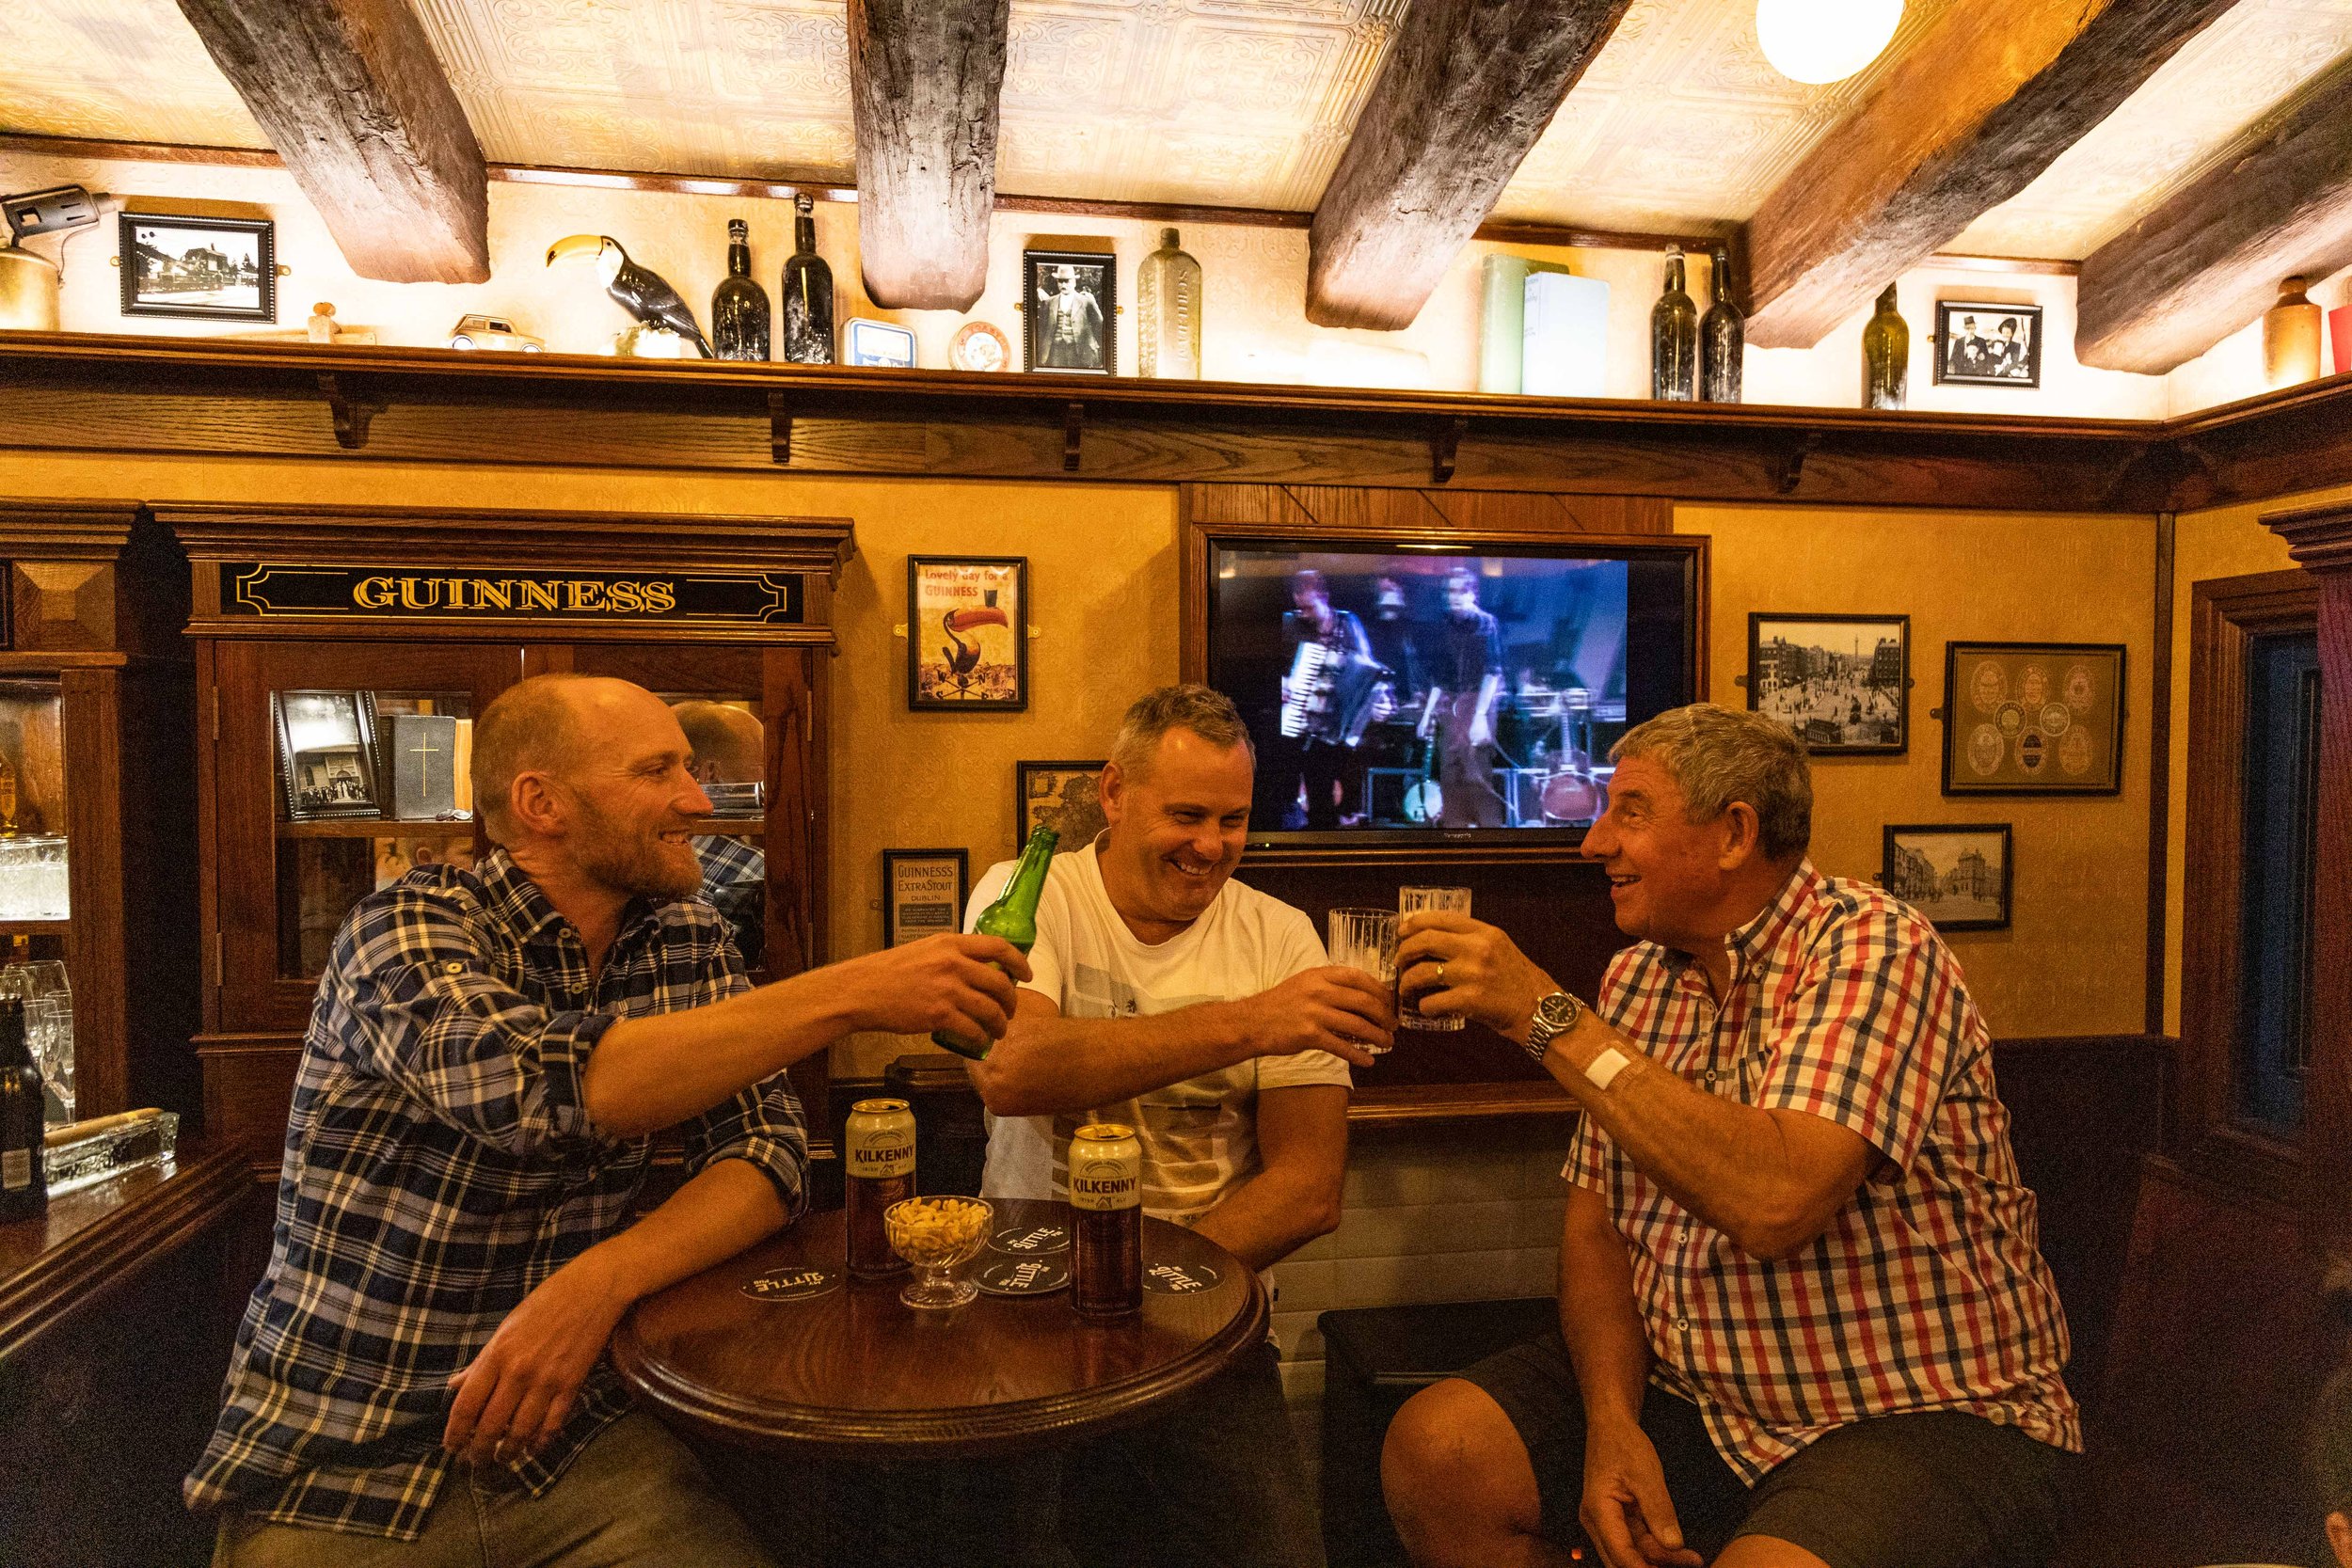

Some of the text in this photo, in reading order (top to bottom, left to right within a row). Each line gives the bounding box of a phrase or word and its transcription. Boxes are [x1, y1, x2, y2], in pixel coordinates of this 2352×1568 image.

[925, 570, 958, 581] Lovely
[353, 576, 675, 613] GUINNESS
[925, 586, 978, 597] GUINNESS
[855, 1144, 914, 1164] KILKENNY
[1073, 1177, 1136, 1194] KILKENNY
[1012, 1227, 1055, 1250] LITTLE
[1009, 1262, 1042, 1289] LITTLE
[1149, 1266, 1203, 1290] LITTLE
